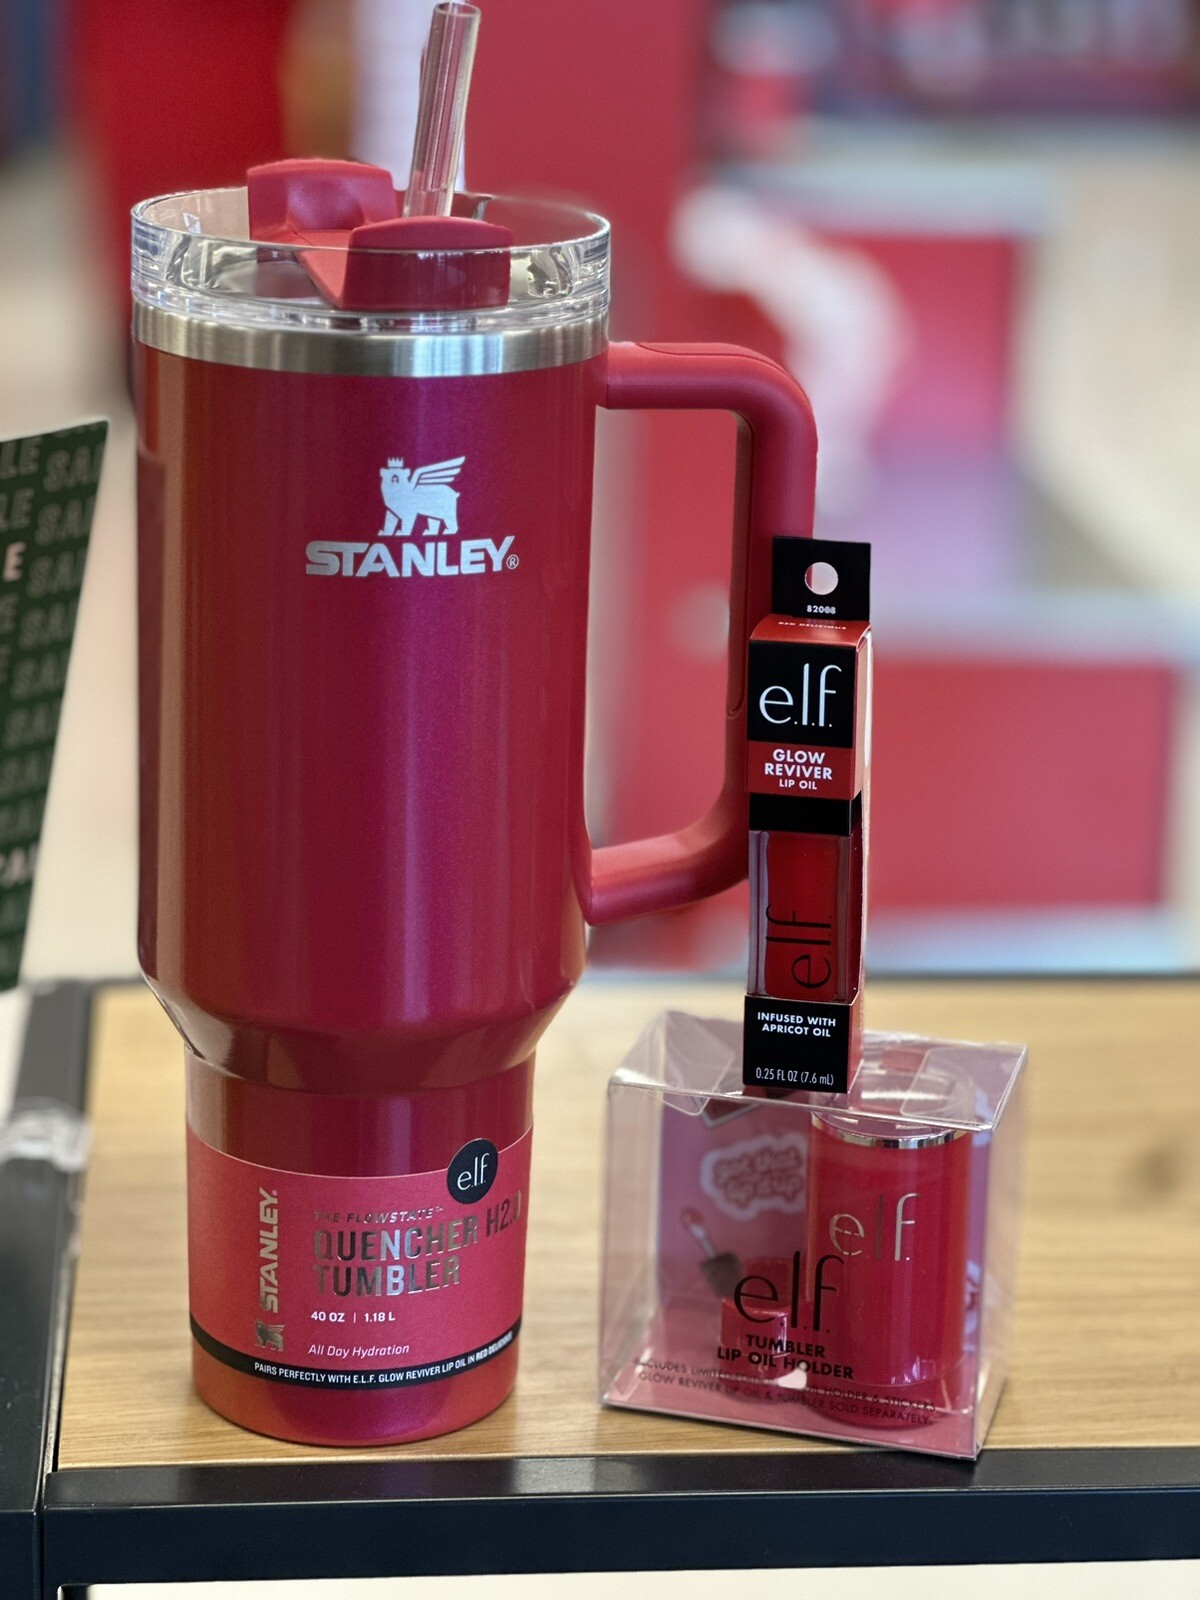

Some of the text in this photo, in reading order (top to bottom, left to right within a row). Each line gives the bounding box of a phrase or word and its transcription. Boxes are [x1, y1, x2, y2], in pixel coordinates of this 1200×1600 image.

[772, 748, 826, 765] GLOW
[764, 762, 833, 780] REVIVER
[779, 778, 818, 790] LIP OIL
[757, 1011, 837, 1027] INFUSED WITH
[761, 1023, 831, 1037] APRICOT OIL
[755, 1067, 834, 1086] 0.25 FL OZ (7.6 mL)
[313, 1215, 479, 1261] QUENCHER
[313, 1255, 460, 1297] TUMBLER
[310, 1311, 396, 1323] 40 OZ 1.18 L
[308, 1342, 410, 1359] All Day Hydration
[746, 1333, 826, 1359] TUMBLER
[254, 1361, 278, 1376] PAIRS
[278, 1367, 327, 1383] PERFECTLY
[328, 1373, 351, 1384] WITH
[353, 1374, 377, 1384] E.L.F.
[378, 1372, 405, 1384] GLOW
[406, 1365, 441, 1380] REVIVER
[441, 1361, 454, 1374] LIP
[455, 1358, 467, 1370] OIL
[467, 1354, 475, 1365] IN
[475, 1348, 489, 1362] RED
[717, 1346, 742, 1362] LIP
[748, 1351, 777, 1368] OIL
[784, 1357, 854, 1380] HOLDER
[638, 1371, 676, 1385] GLOW
[678, 1377, 722, 1393] REVIVER
[829, 1400, 859, 1414] SOLD
[824, 1386, 868, 1400] HOLDER
